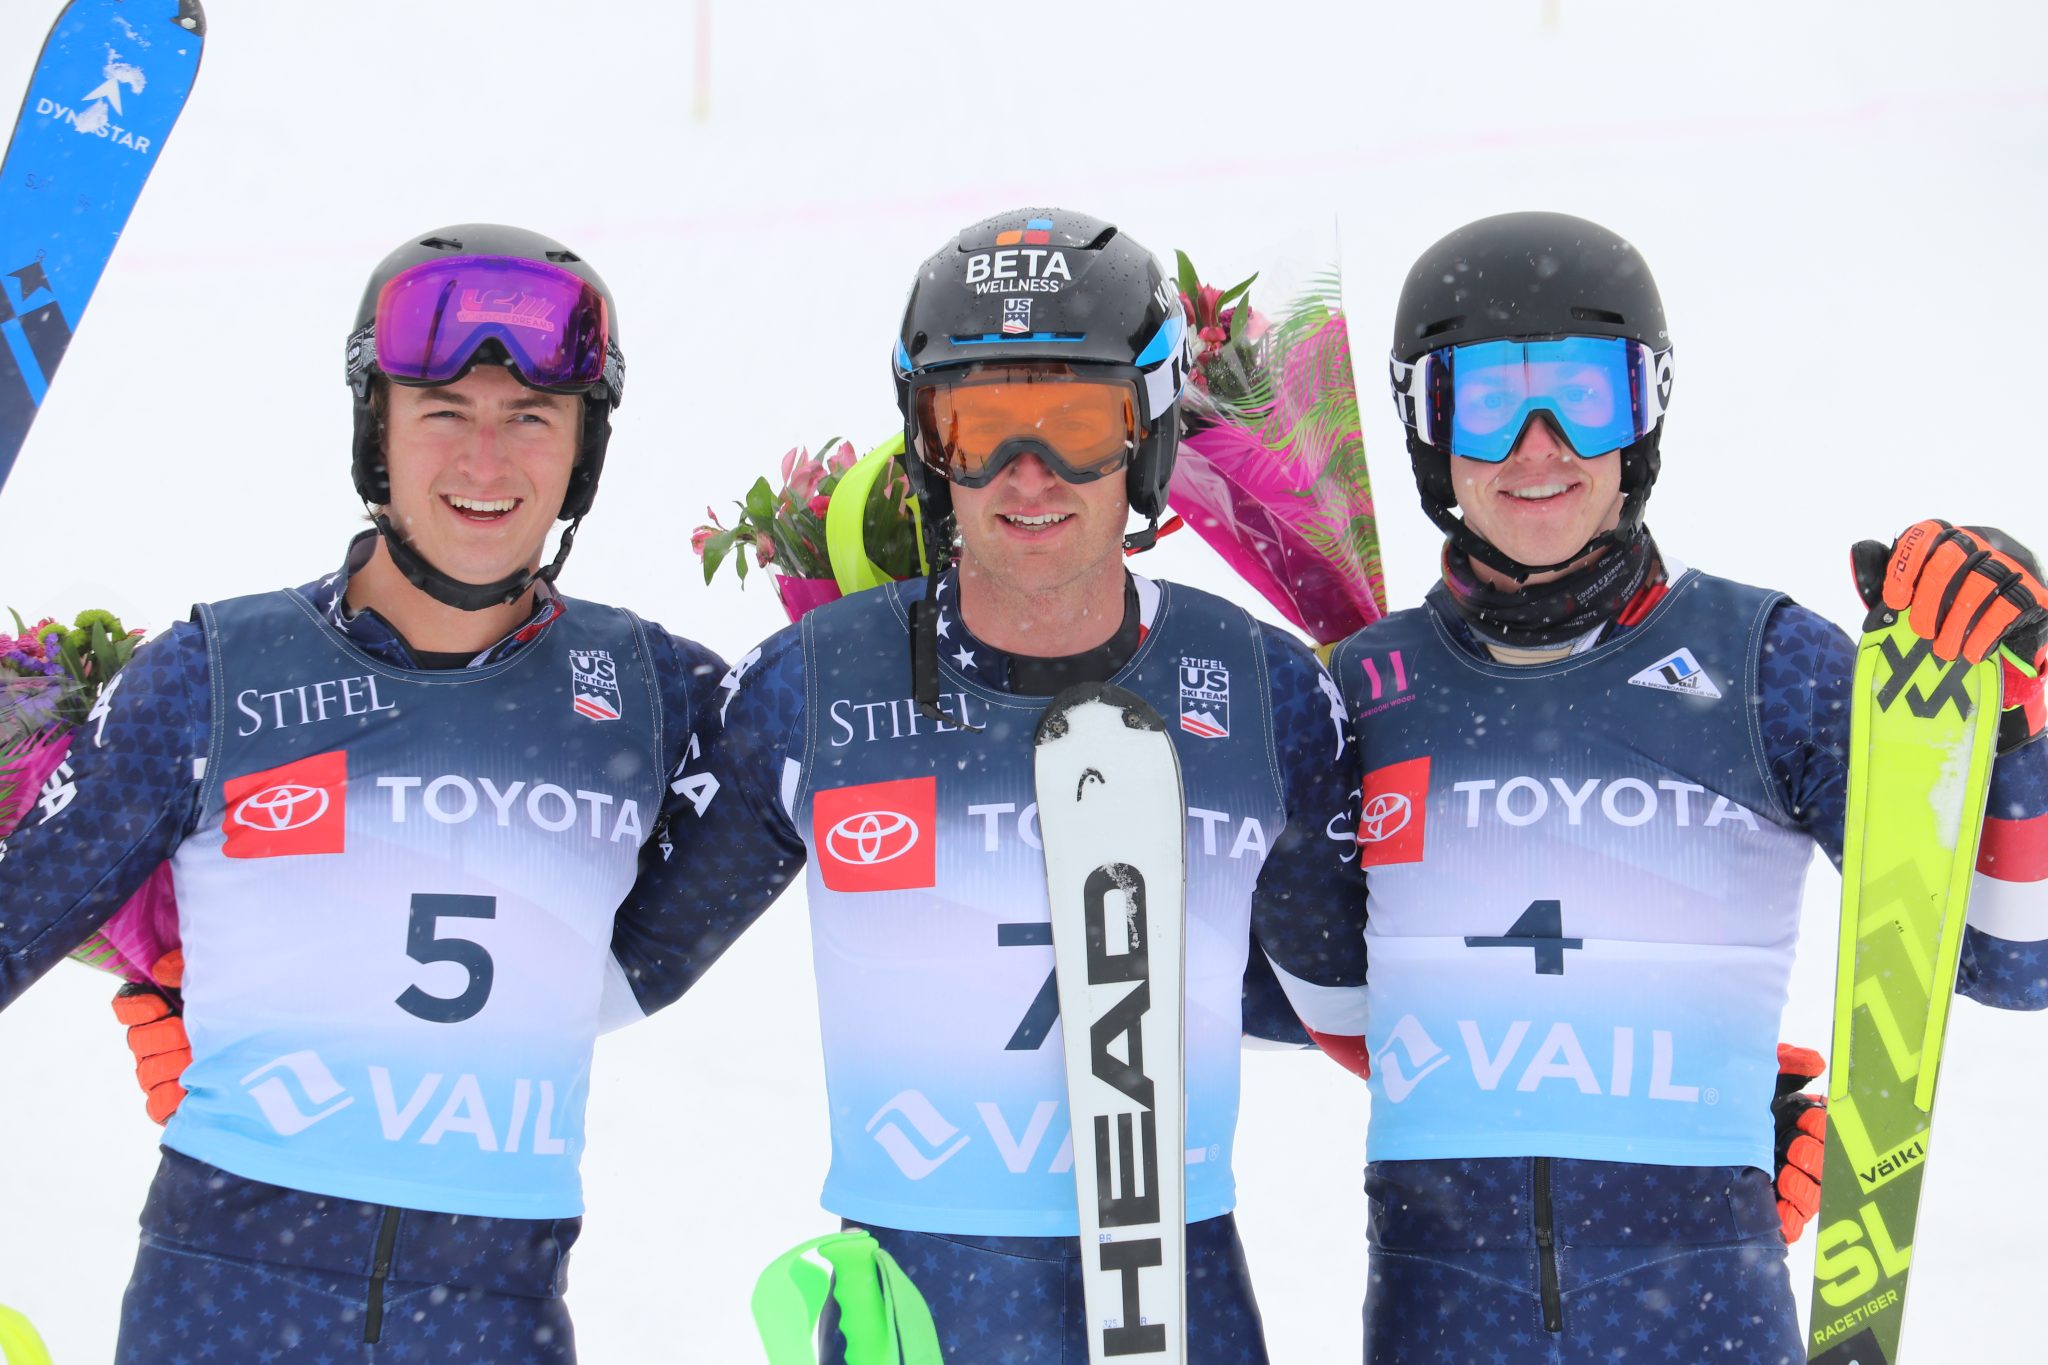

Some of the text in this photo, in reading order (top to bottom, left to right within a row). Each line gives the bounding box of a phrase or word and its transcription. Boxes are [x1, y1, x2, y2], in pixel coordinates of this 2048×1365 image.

[966, 249, 1072, 284] BETA
[976, 278, 1060, 295] WELLNESS
[512, 313, 554, 332] DREAMS
[1004, 299, 1030, 312] US
[569, 649, 614, 662] STIFEL
[571, 657, 615, 682] US
[1181, 656, 1226, 670] STIFEL
[575, 672, 617, 689] SKI TEAM
[1180, 667, 1228, 693] US
[1181, 688, 1228, 702] SKI TEAM
[236, 675, 396, 737] STIFEL
[376, 774, 643, 848] TOYOTA
[395, 893, 497, 1024] 5
[1457, 1019, 1700, 1103] VAIL
[368, 1065, 566, 1155] VAIL
[1083, 862, 1167, 1358] HEAD
[1859, 1141, 1925, 1184] Völkl
[1814, 1200, 1913, 1308] SL
[1813, 1289, 1899, 1345] RACETIGER
